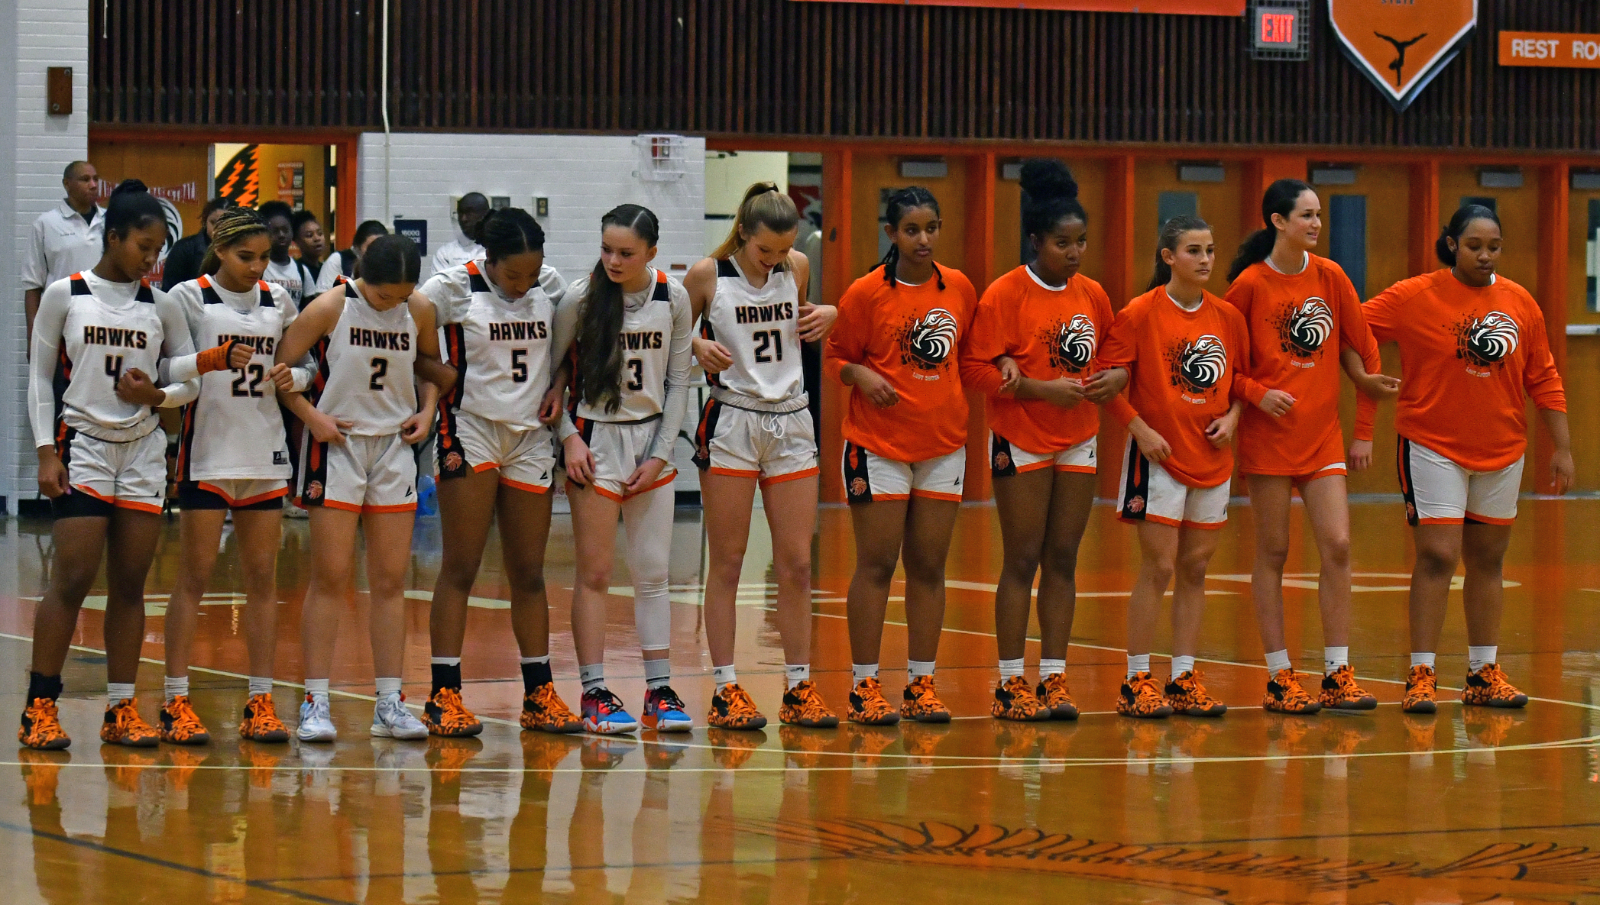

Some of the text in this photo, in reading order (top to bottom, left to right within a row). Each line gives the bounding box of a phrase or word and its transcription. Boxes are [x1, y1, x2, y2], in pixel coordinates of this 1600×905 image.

[1261, 13, 1294, 43] EXIT
[1511, 38, 1600, 60] REST RO
[735, 301, 794, 325] HAWKS
[83, 325, 147, 350] HAWKS
[349, 326, 410, 351] HAWKS
[488, 320, 548, 342] HAWKS
[617, 331, 663, 350] AWKS
[752, 328, 783, 365] 21
[104, 353, 124, 392] 4
[231, 362, 264, 398] 22
[369, 356, 389, 391] 2
[511, 348, 529, 384] 5
[627, 357, 644, 392] 3
